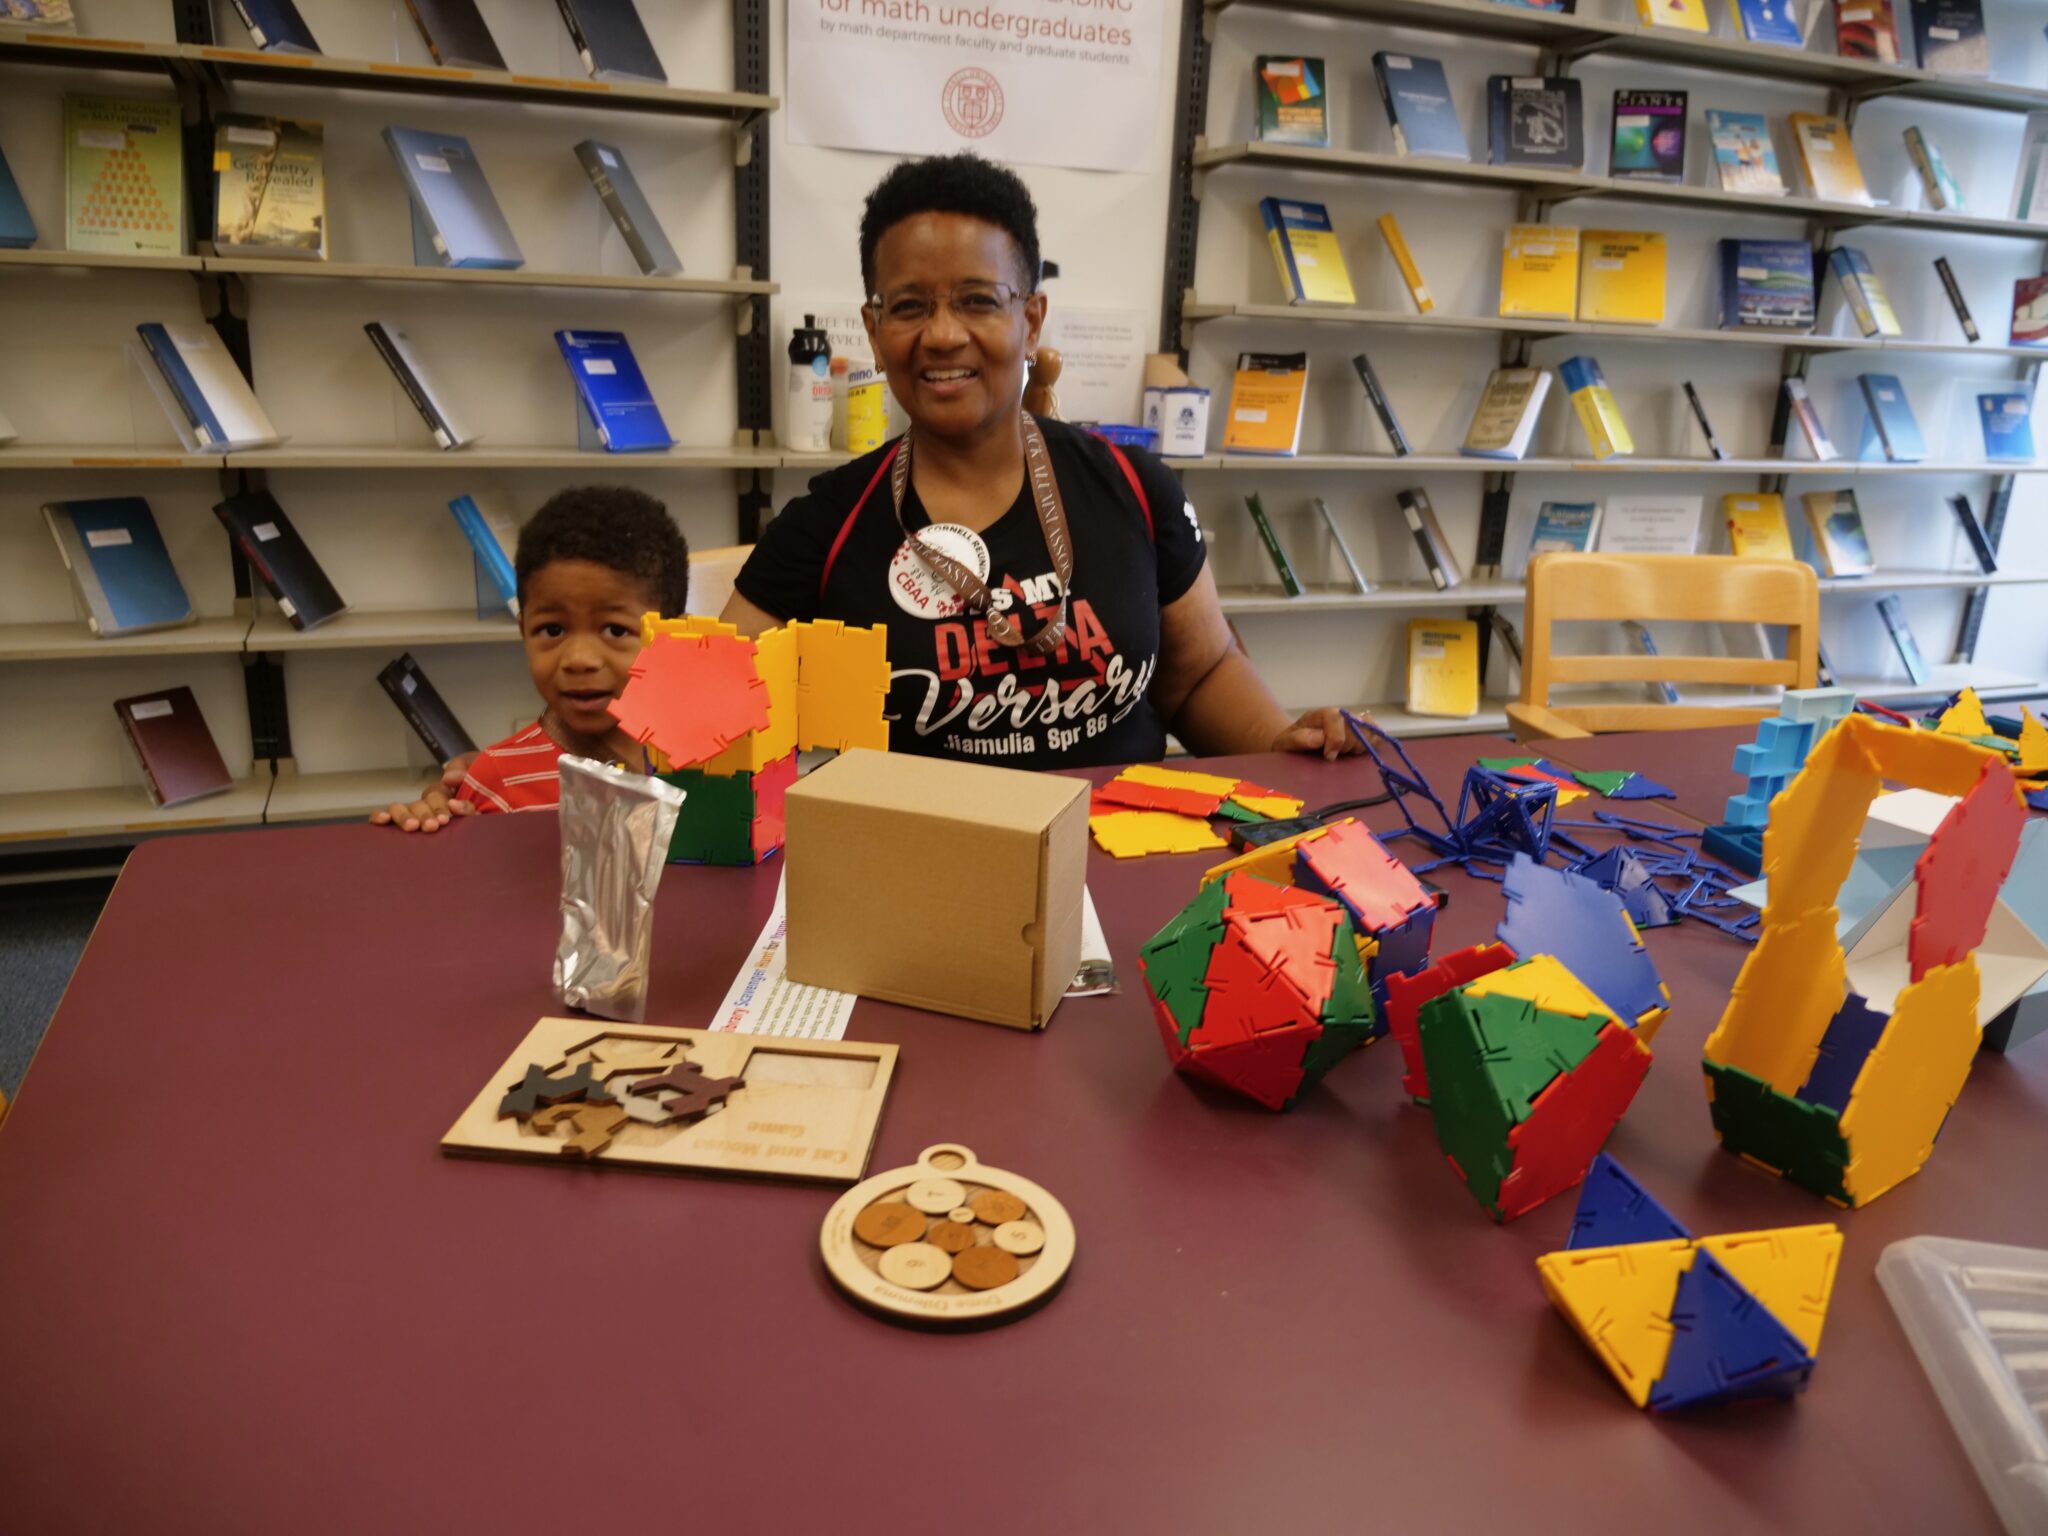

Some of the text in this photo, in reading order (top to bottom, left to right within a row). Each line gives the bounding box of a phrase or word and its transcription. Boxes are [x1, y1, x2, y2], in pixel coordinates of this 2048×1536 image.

[819, 0, 1132, 46] for math undergraduates
[820, 18, 1130, 65] by math department faculty and graduate students
[233, 158, 311, 177] Geometry
[246, 172, 314, 188] Revealed
[815, 315, 840, 329] REE
[827, 334, 867, 346] RVICE
[848, 367, 873, 382] mino
[1033, 464, 1059, 525] ALUMNI
[926, 524, 987, 579] CORNELL REUNIO
[896, 571, 930, 610] CBAA
[1024, 571, 1071, 607] MY
[884, 654, 1156, 737] Versary
[1047, 726, 1080, 752] Spr
[1086, 712, 1109, 739] 86
[734, 968, 767, 1007] Scavenger
[720, 1006, 751, 1032] ibrary
[746, 1121, 806, 1138] Game
[693, 1138, 849, 1164] Cat and Mouse
